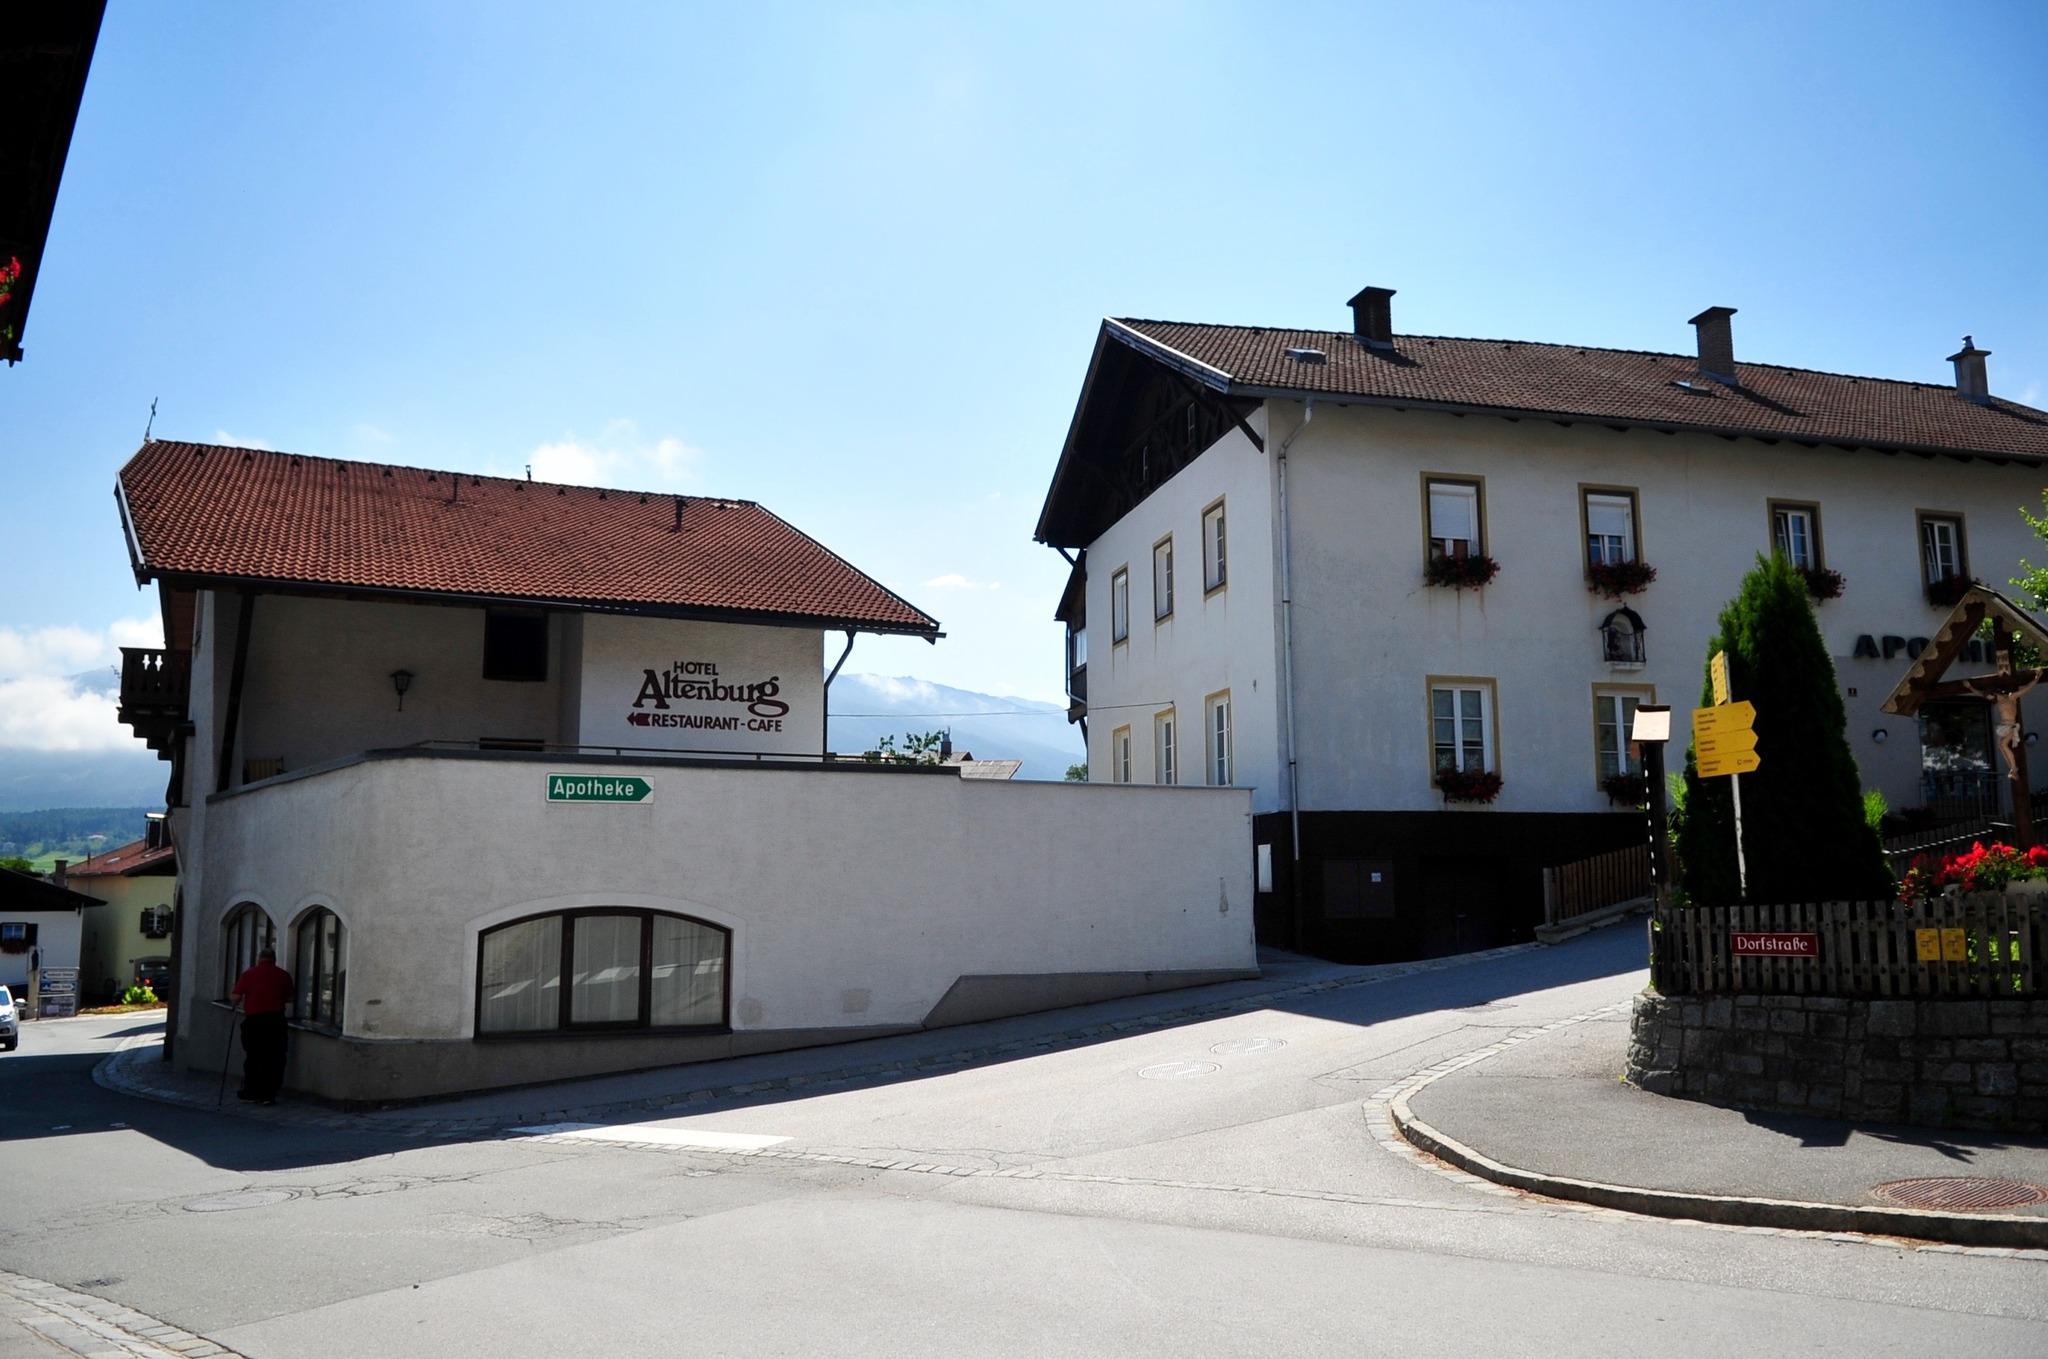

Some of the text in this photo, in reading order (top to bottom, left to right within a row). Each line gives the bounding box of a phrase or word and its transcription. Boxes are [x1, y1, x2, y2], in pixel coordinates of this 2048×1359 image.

[673, 661, 719, 676] HOTEL
[632, 668, 790, 718] Altenburg
[554, 778, 634, 799] Apotheke
[1737, 936, 1808, 951] Dorfstraße
